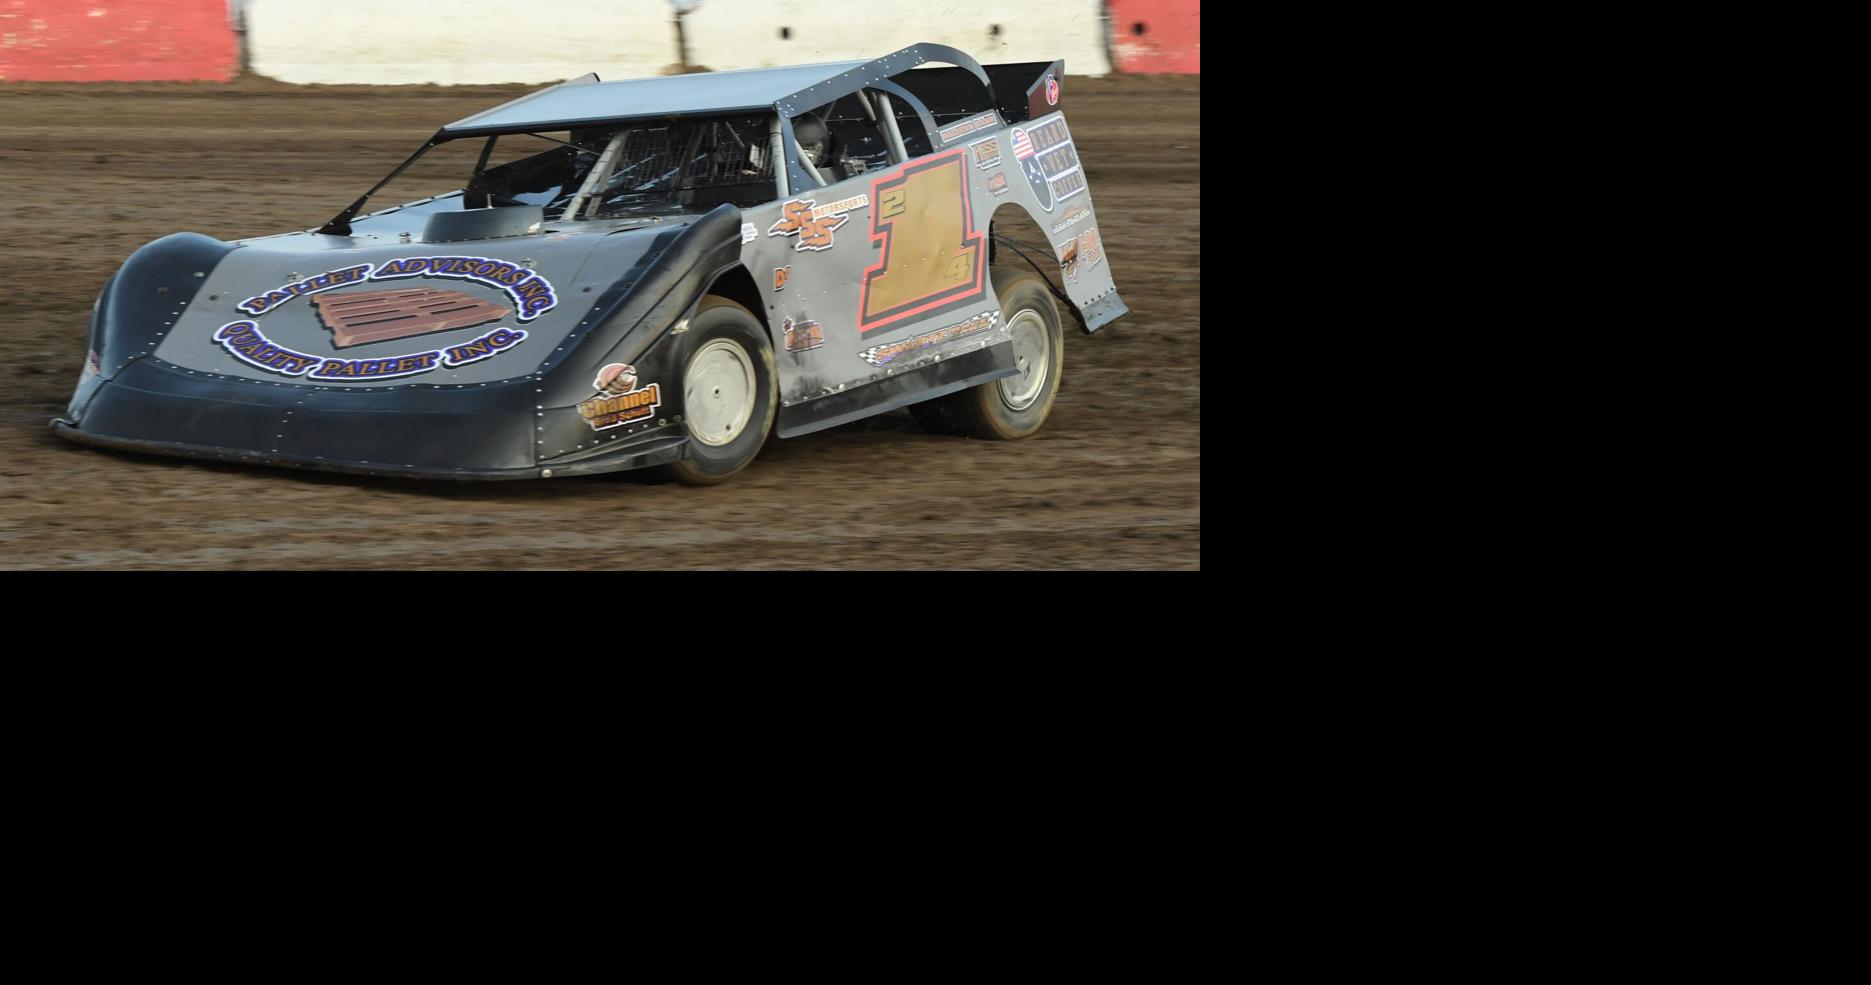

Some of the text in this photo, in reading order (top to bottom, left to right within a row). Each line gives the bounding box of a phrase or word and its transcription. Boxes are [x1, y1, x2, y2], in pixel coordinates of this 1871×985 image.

[1029, 119, 1068, 151] BEARD
[813, 194, 869, 217] MOTORSPORTS
[882, 188, 906, 219] 2
[858, 148, 984, 333] 1
[943, 252, 971, 281] 4
[248, 257, 553, 317] PALLET ADVISORS INC.
[225, 322, 524, 377] QUALITY PALLET INC.
